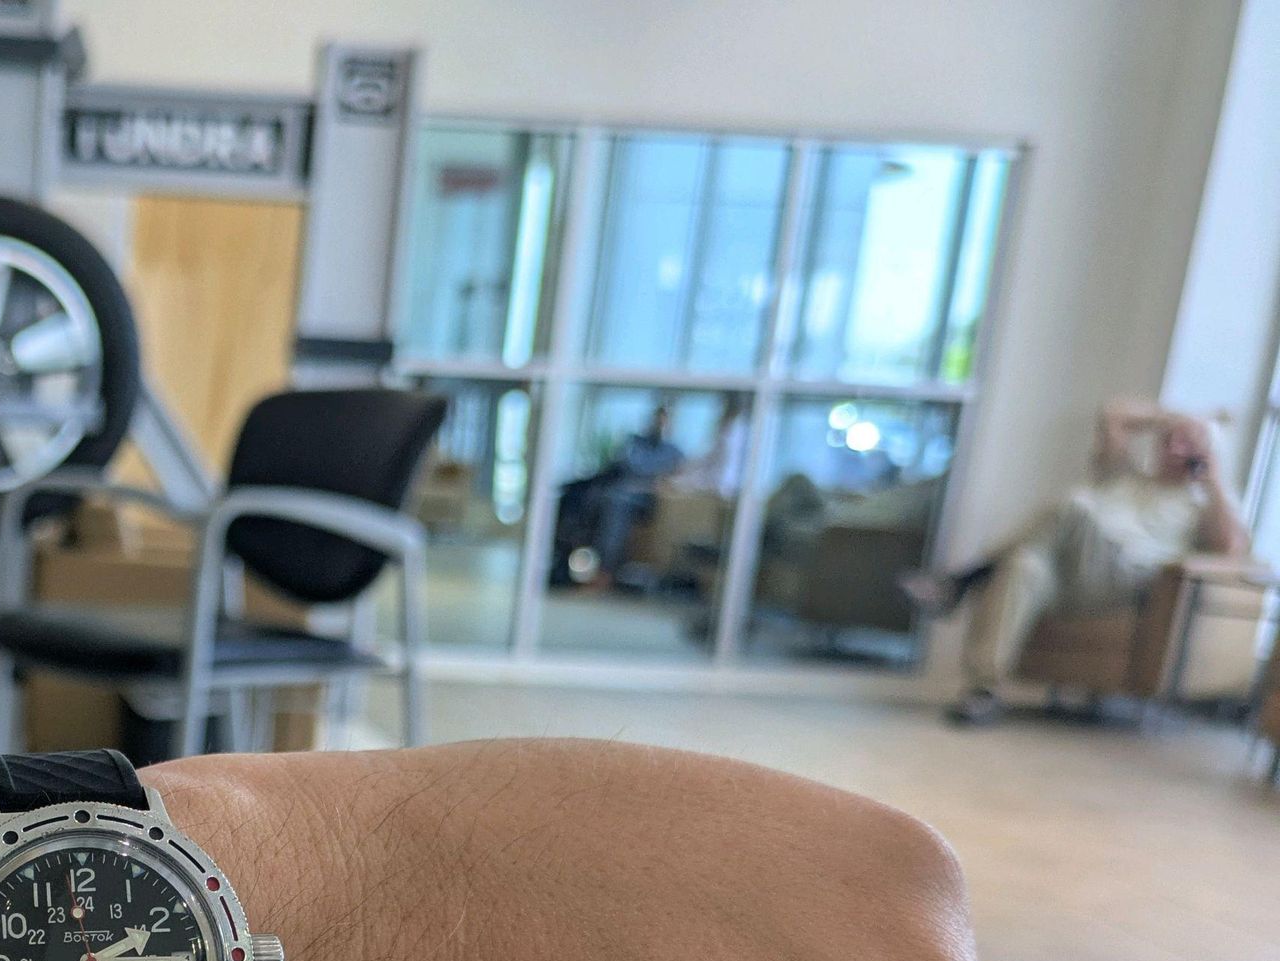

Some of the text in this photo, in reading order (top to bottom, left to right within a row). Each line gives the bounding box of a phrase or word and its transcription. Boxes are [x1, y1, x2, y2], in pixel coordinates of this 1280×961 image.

[75, 112, 278, 172] TUNDRA
[70, 868, 96, 892] 12
[125, 879, 132, 903] 1
[33, 882, 52, 908] 11
[76, 896, 95, 912] 24
[47, 906, 66, 924] 23
[109, 903, 123, 919] 13
[149, 906, 171, 933] 2
[1, 912, 27, 940] 10
[27, 929, 46, 945] 22
